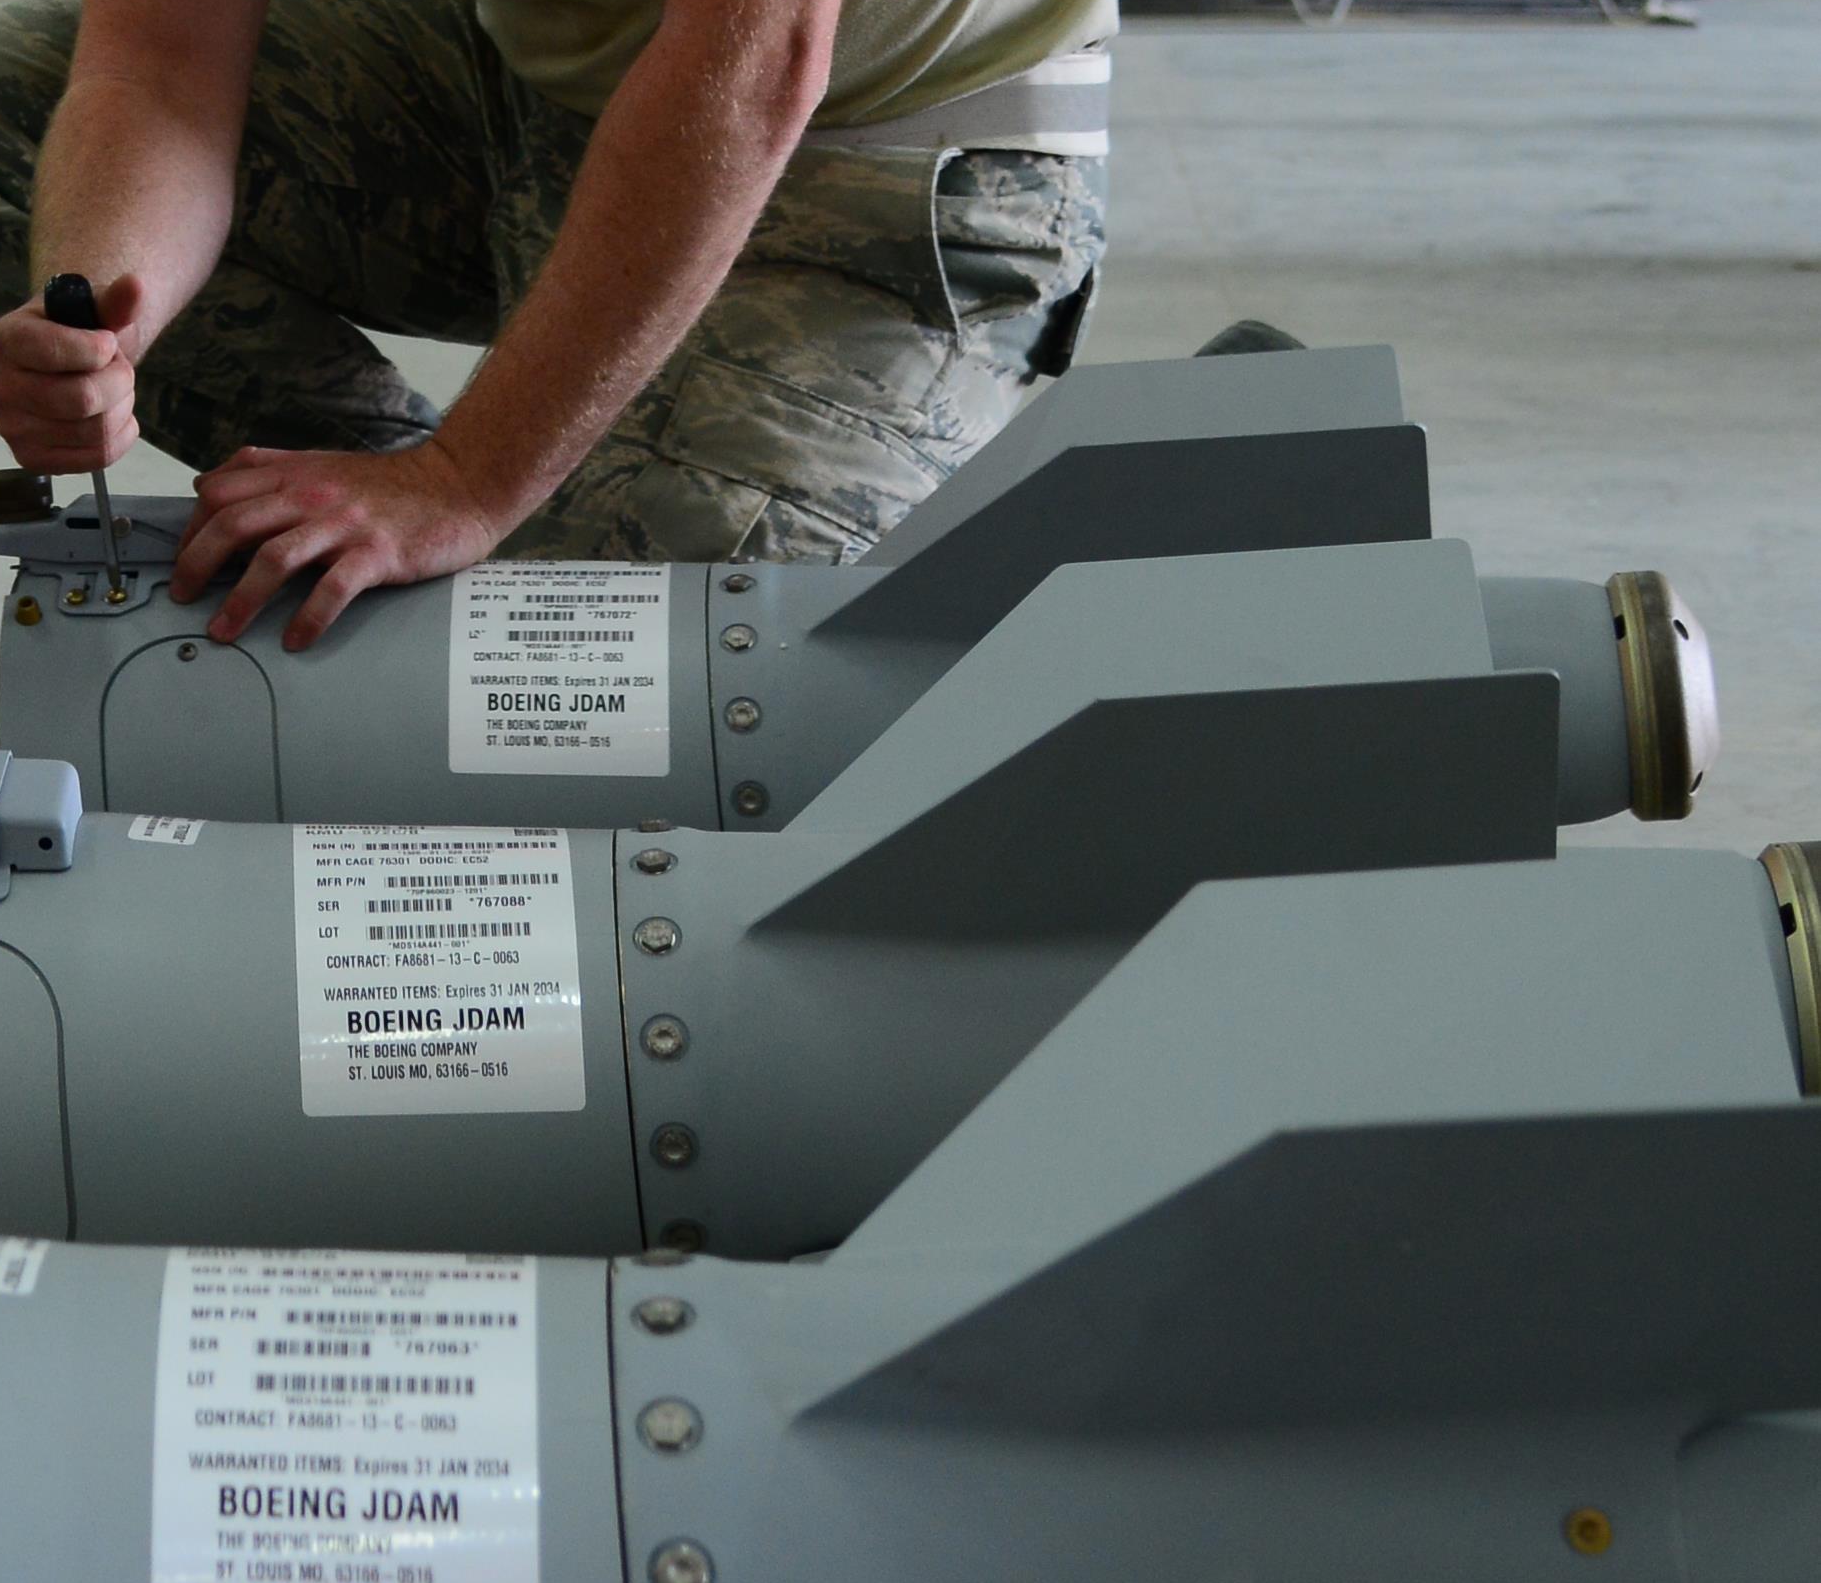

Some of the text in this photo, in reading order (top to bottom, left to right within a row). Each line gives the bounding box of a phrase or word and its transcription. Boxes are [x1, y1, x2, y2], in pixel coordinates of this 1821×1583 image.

[469, 610, 487, 619] SER
[470, 675, 528, 686] WARRANTED
[612, 676, 630, 687] JAN
[487, 693, 625, 713] BOEING JDAM
[486, 719, 587, 731] THE BOEING COMPANY
[503, 735, 530, 747] LOUIS
[316, 858, 341, 867] MFR
[345, 857, 375, 866] CAGE
[379, 857, 410, 866] 76301
[462, 856, 490, 864] EC52
[316, 876, 366, 887] MFR P/N
[317, 900, 340, 912] SER
[318, 926, 339, 939] LOT
[326, 954, 390, 969] CONTRACT:
[324, 981, 560, 1002] WARRANTED ITEMS: Expires 31 JAN 2034
[347, 1006, 526, 1035] BOEING JDAM
[347, 1041, 478, 1059] THE BOEING COMPANY
[348, 1065, 367, 1081] ST.
[371, 1063, 406, 1080] LOUIS
[189, 1337, 219, 1352] SER
[187, 1370, 214, 1386] LOT
[189, 1451, 288, 1471] WARRANTED
[354, 1454, 408, 1477] Expires
[439, 1456, 469, 1476] JAN
[218, 1483, 460, 1524] BOEING JDAM
[217, 1530, 244, 1550] THE
[252, 1531, 310, 1553] BOEING
[247, 1560, 292, 1582] LOUIS
